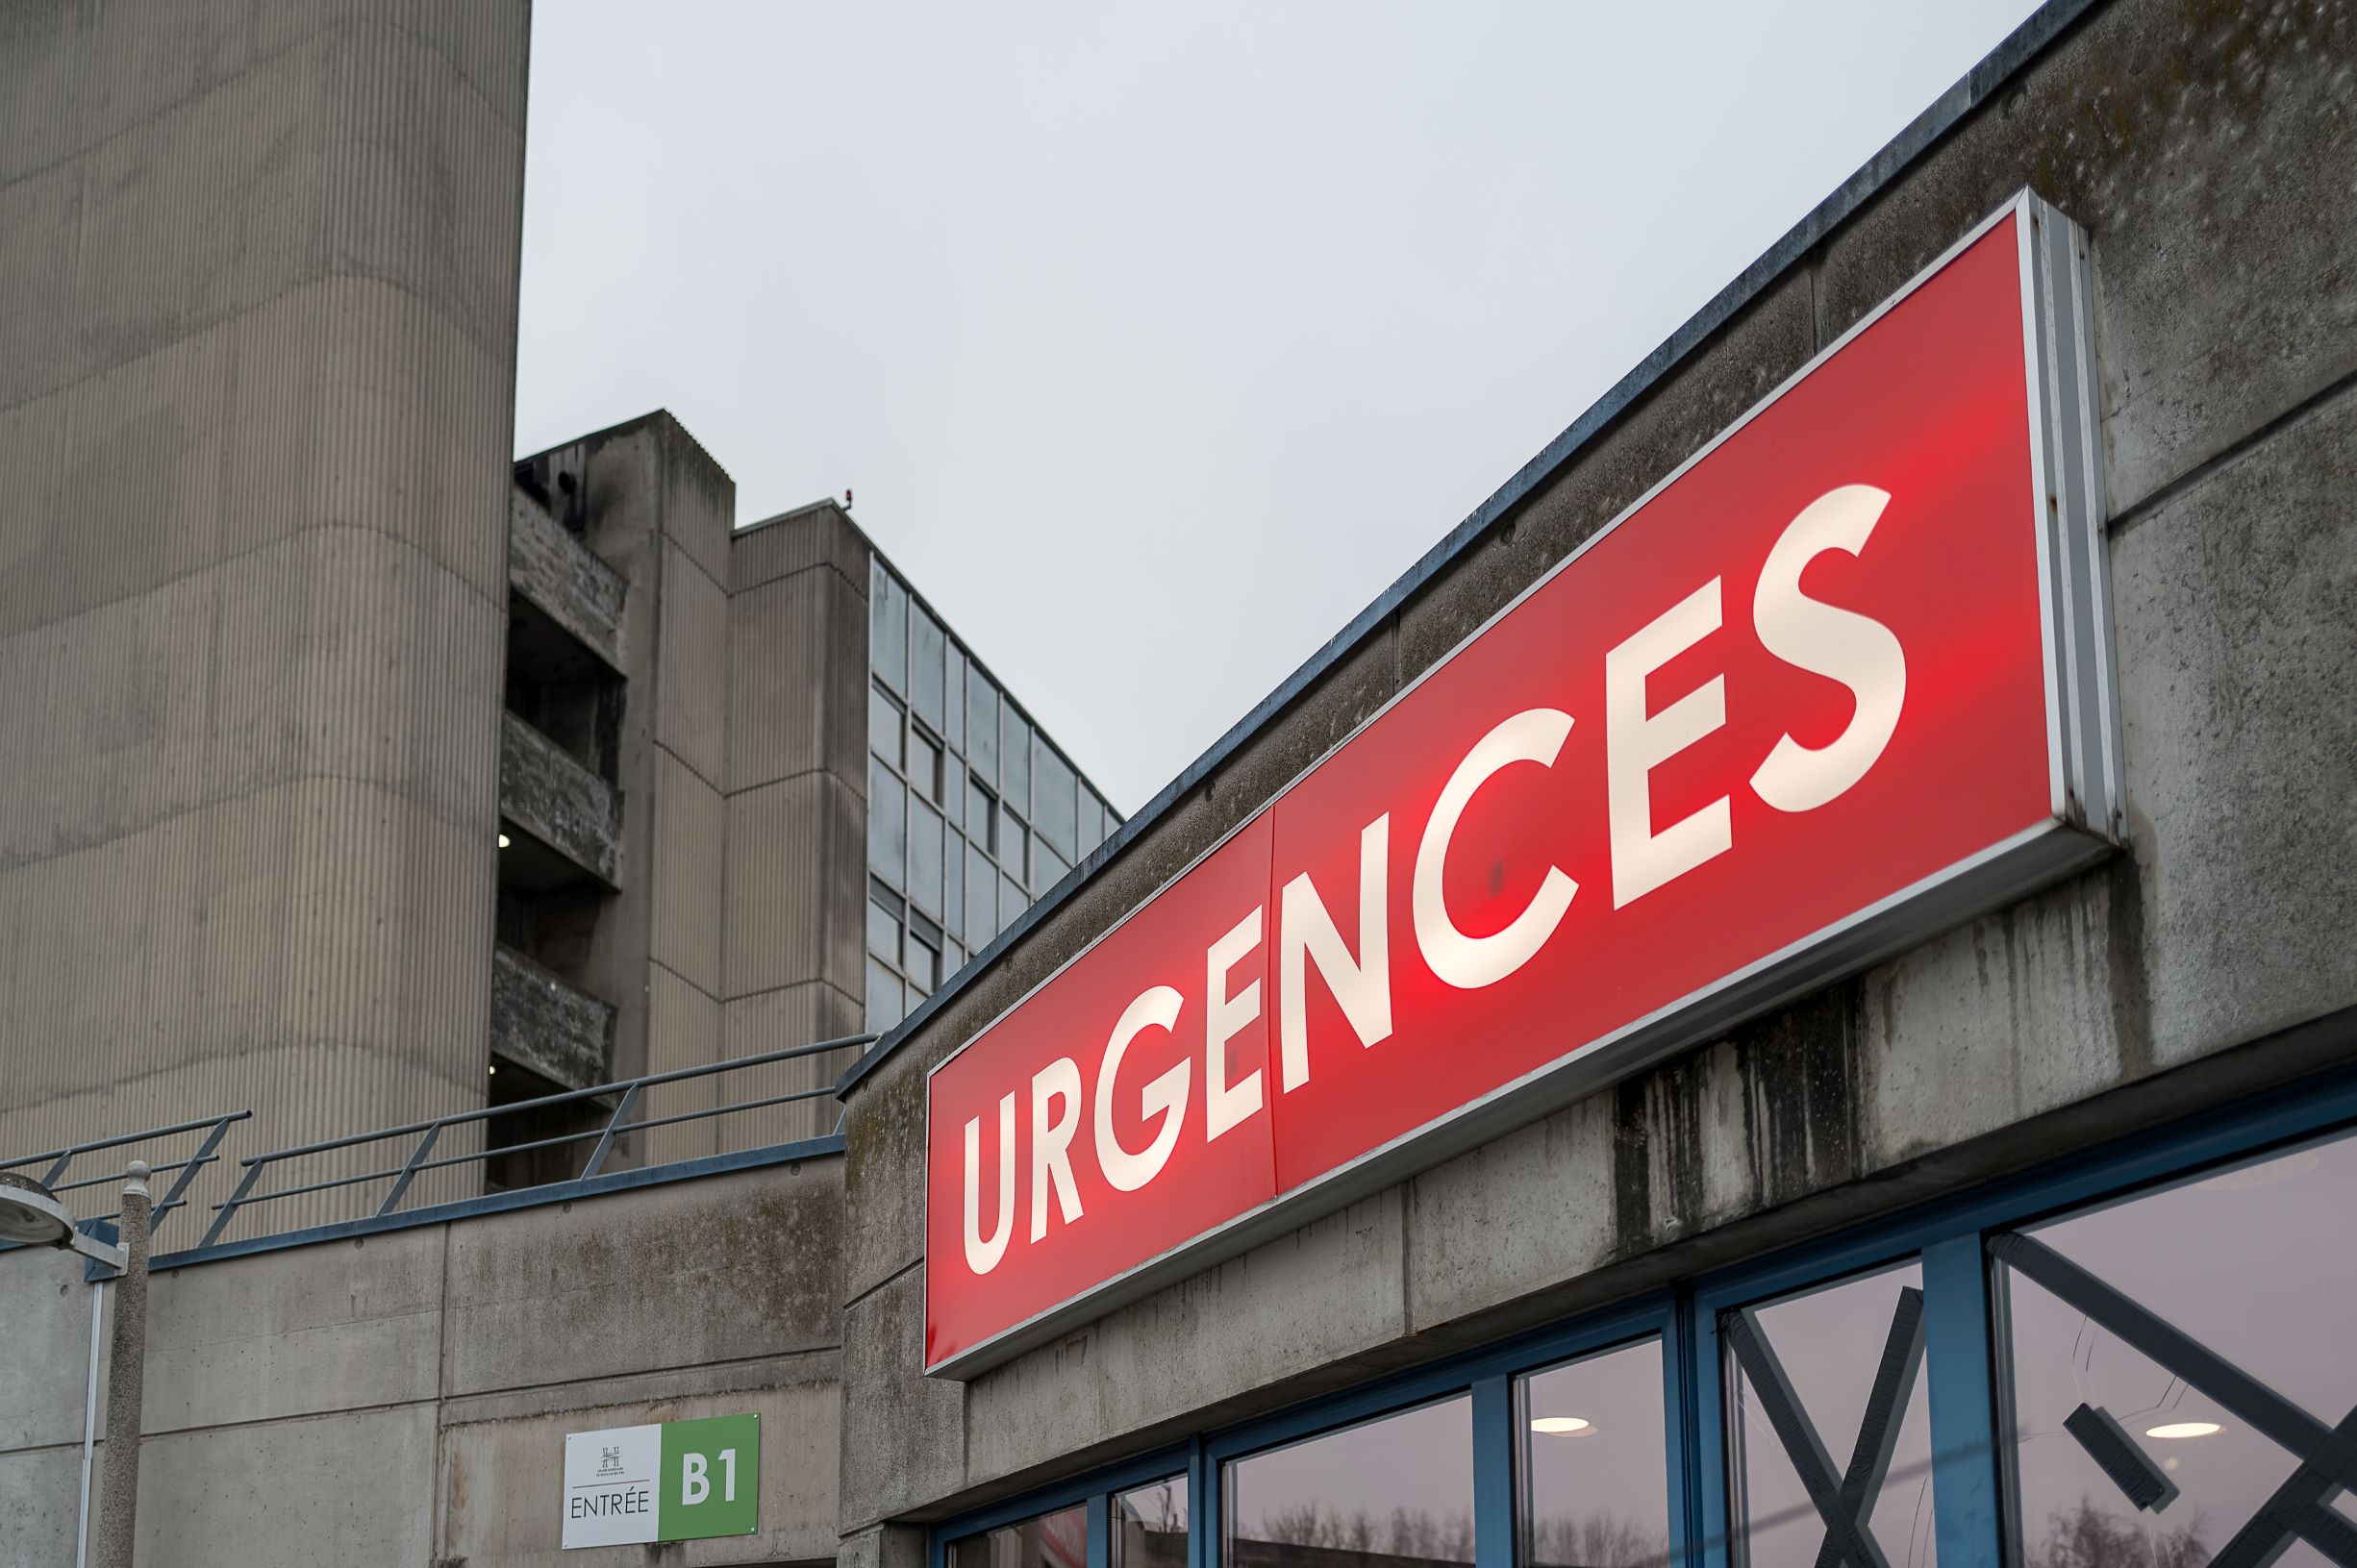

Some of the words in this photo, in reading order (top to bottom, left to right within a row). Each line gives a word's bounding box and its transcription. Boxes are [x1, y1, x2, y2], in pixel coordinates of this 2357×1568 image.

[964, 484, 1907, 1276] URGENCES
[570, 1485, 649, 1519] ENTRÉE
[682, 1448, 736, 1506] B1
